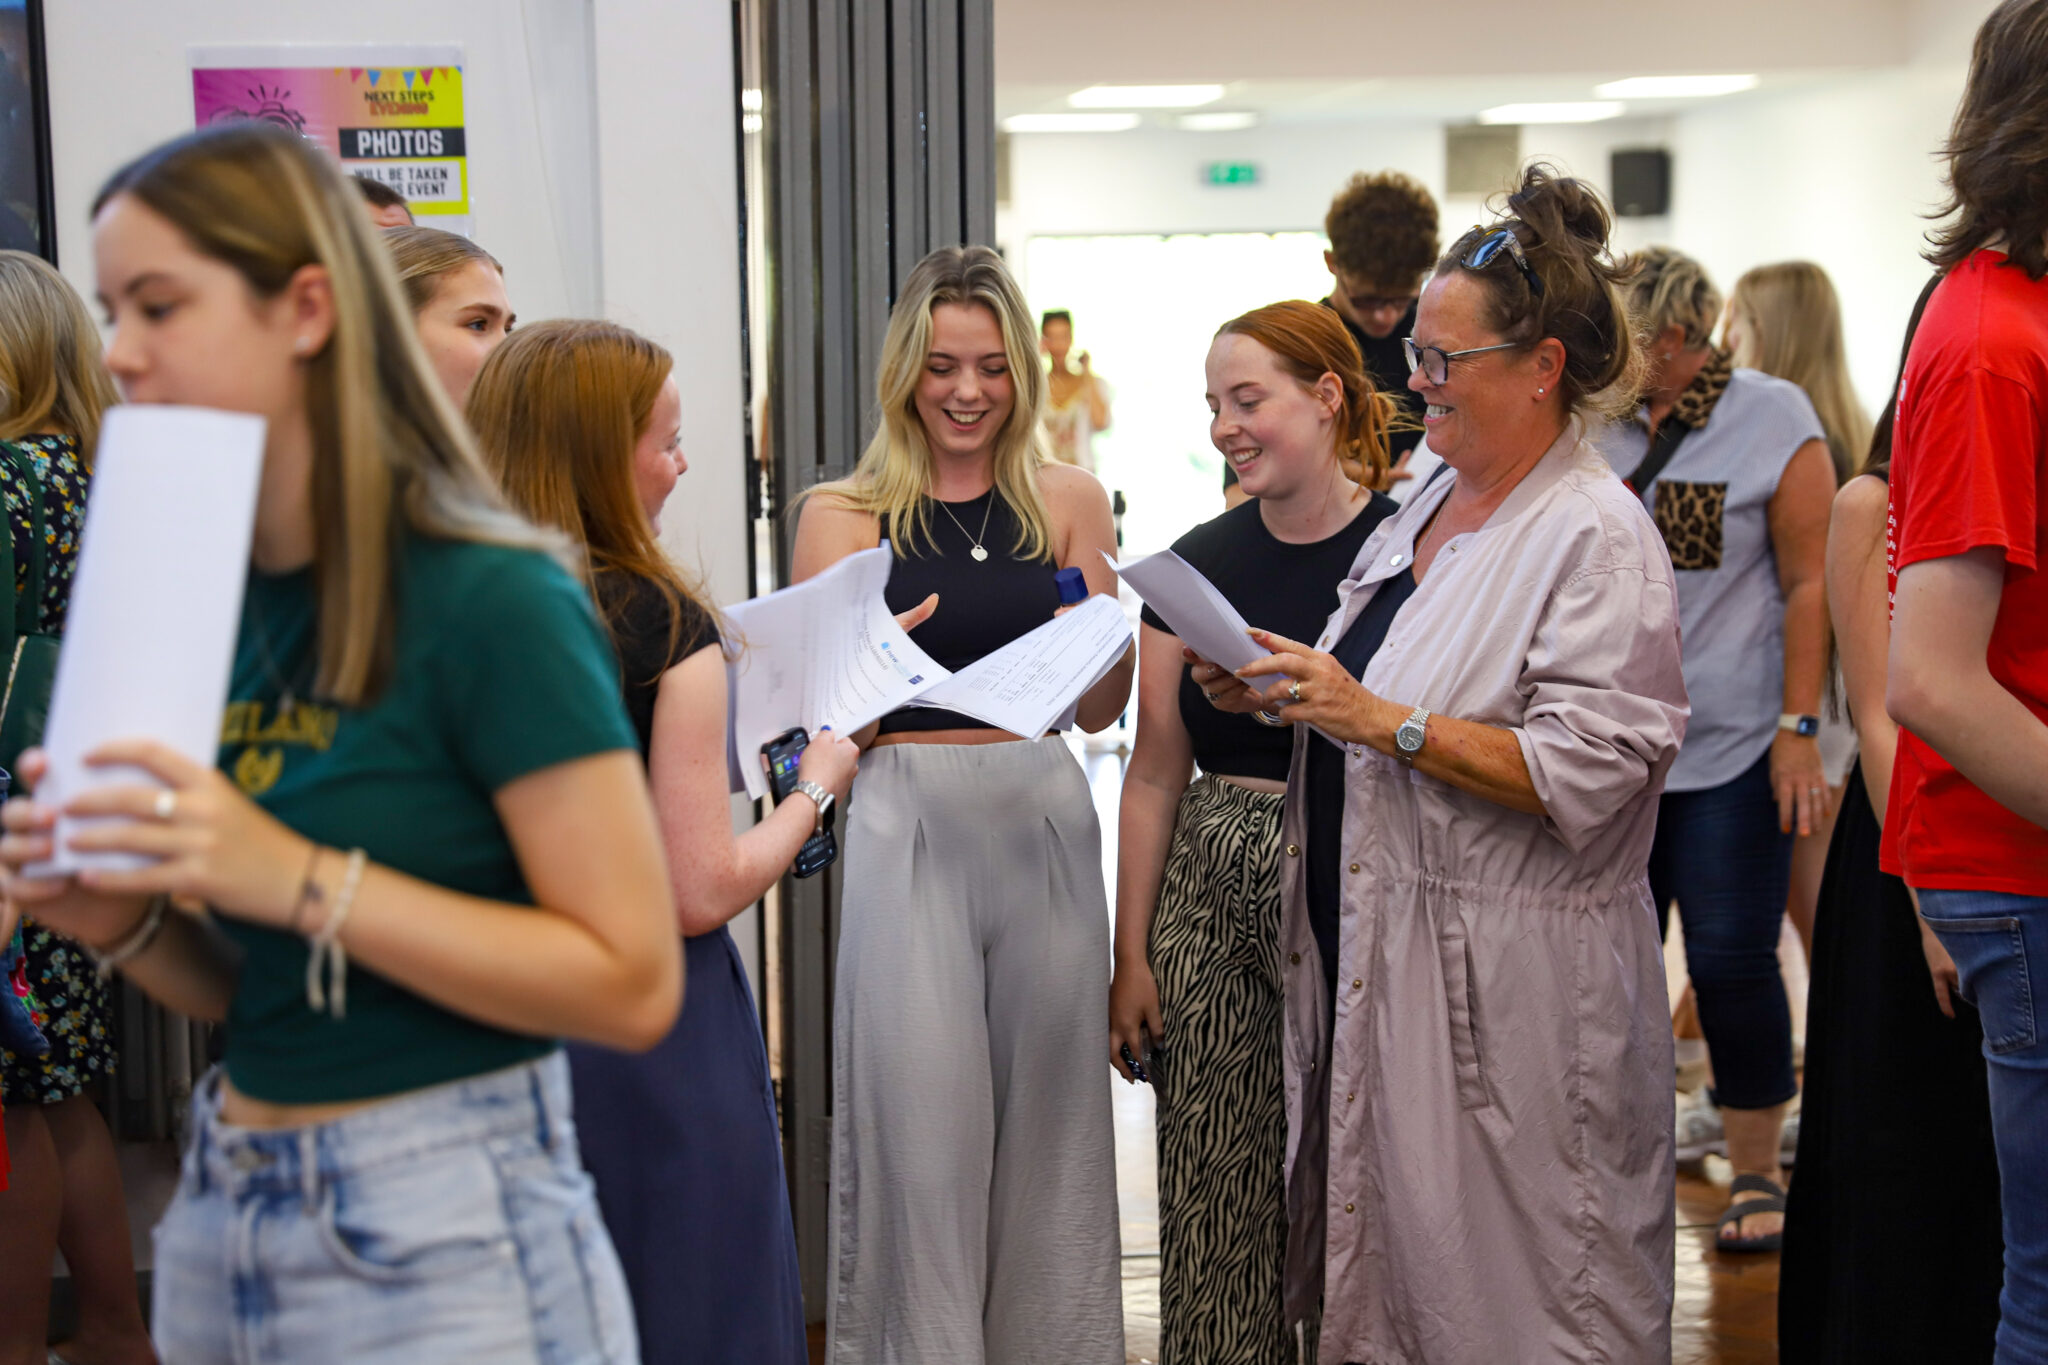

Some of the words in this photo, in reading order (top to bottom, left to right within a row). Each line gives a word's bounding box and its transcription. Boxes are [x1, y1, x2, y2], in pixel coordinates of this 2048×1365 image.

[364, 90, 395, 102] NEXT
[399, 90, 435, 102] STEPS
[357, 129, 444, 157] PHOTOS
[389, 167, 403, 181] BE
[408, 166, 448, 180] TAKEN
[408, 181, 445, 196] EVENT
